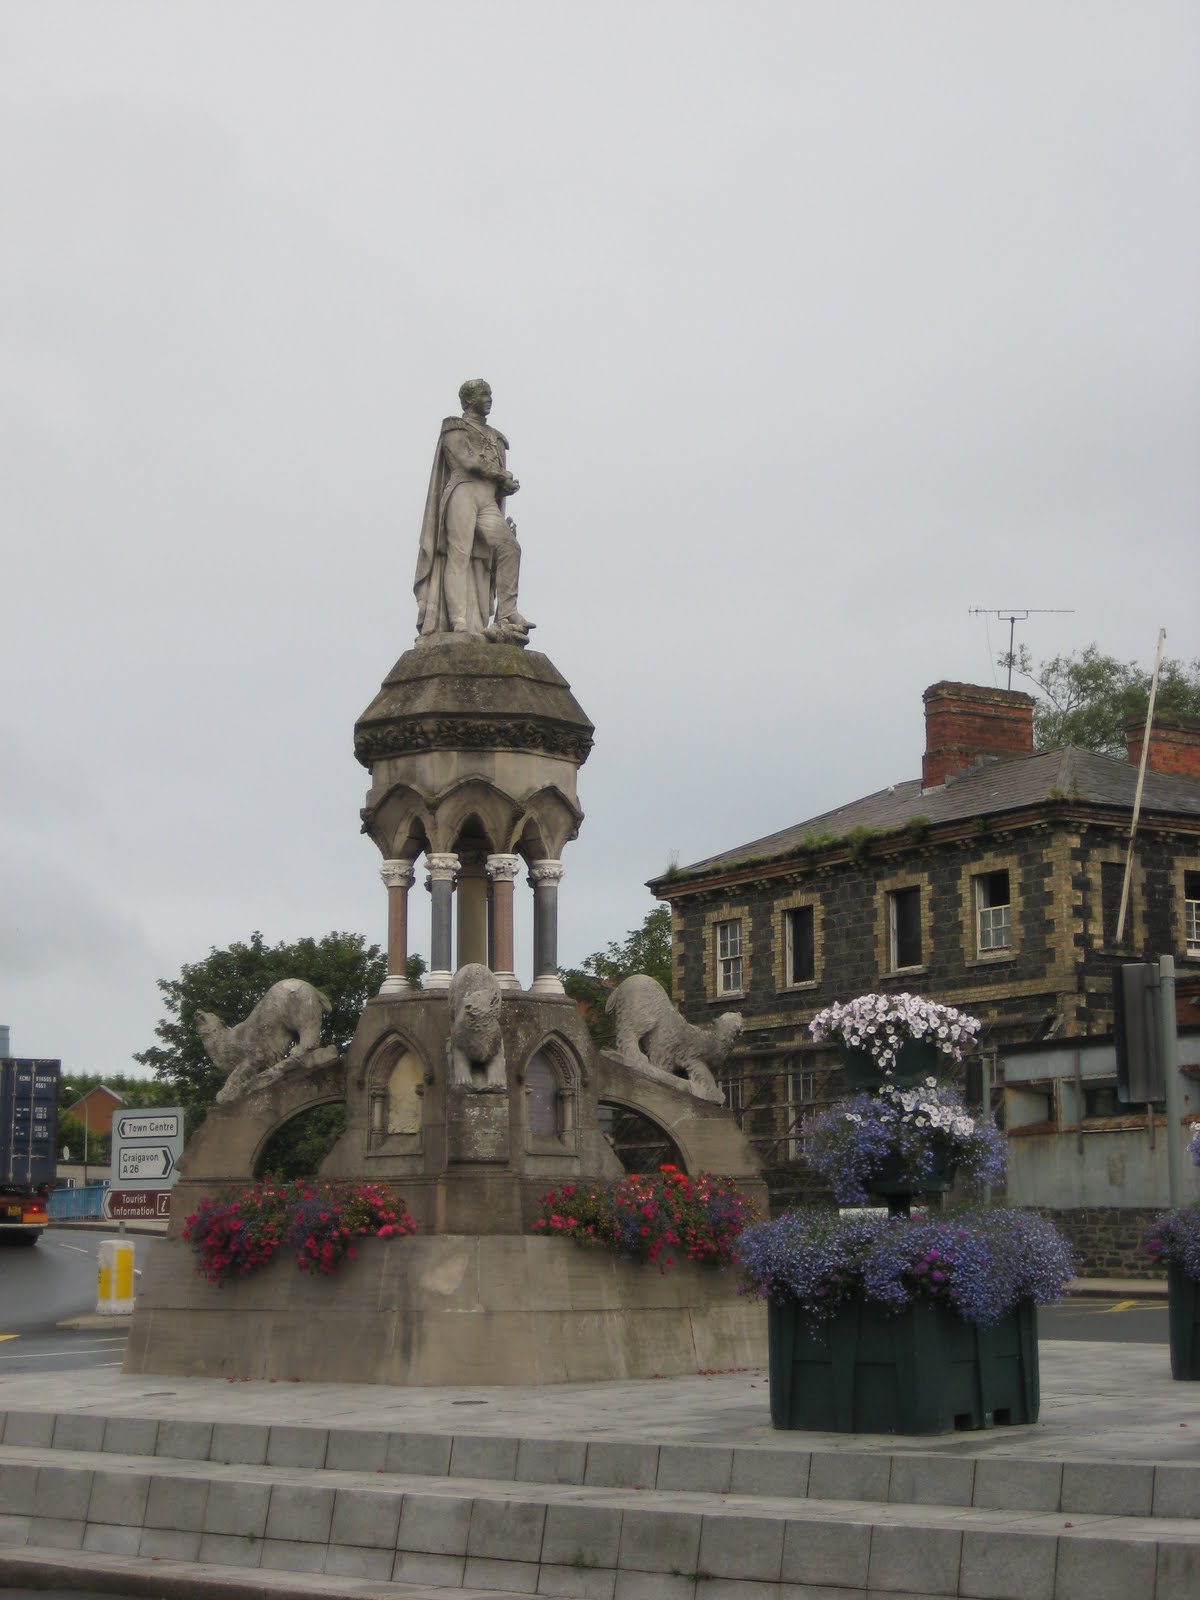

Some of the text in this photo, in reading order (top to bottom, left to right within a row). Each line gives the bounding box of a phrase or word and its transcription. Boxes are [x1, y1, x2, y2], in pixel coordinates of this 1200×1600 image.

[128, 1122, 174, 1132] Town Centre
[122, 1153, 159, 1163] Craigavon
[122, 1164, 140, 1174] A 26
[122, 1193, 147, 1204] Tourist
[113, 1206, 155, 1216] Information
